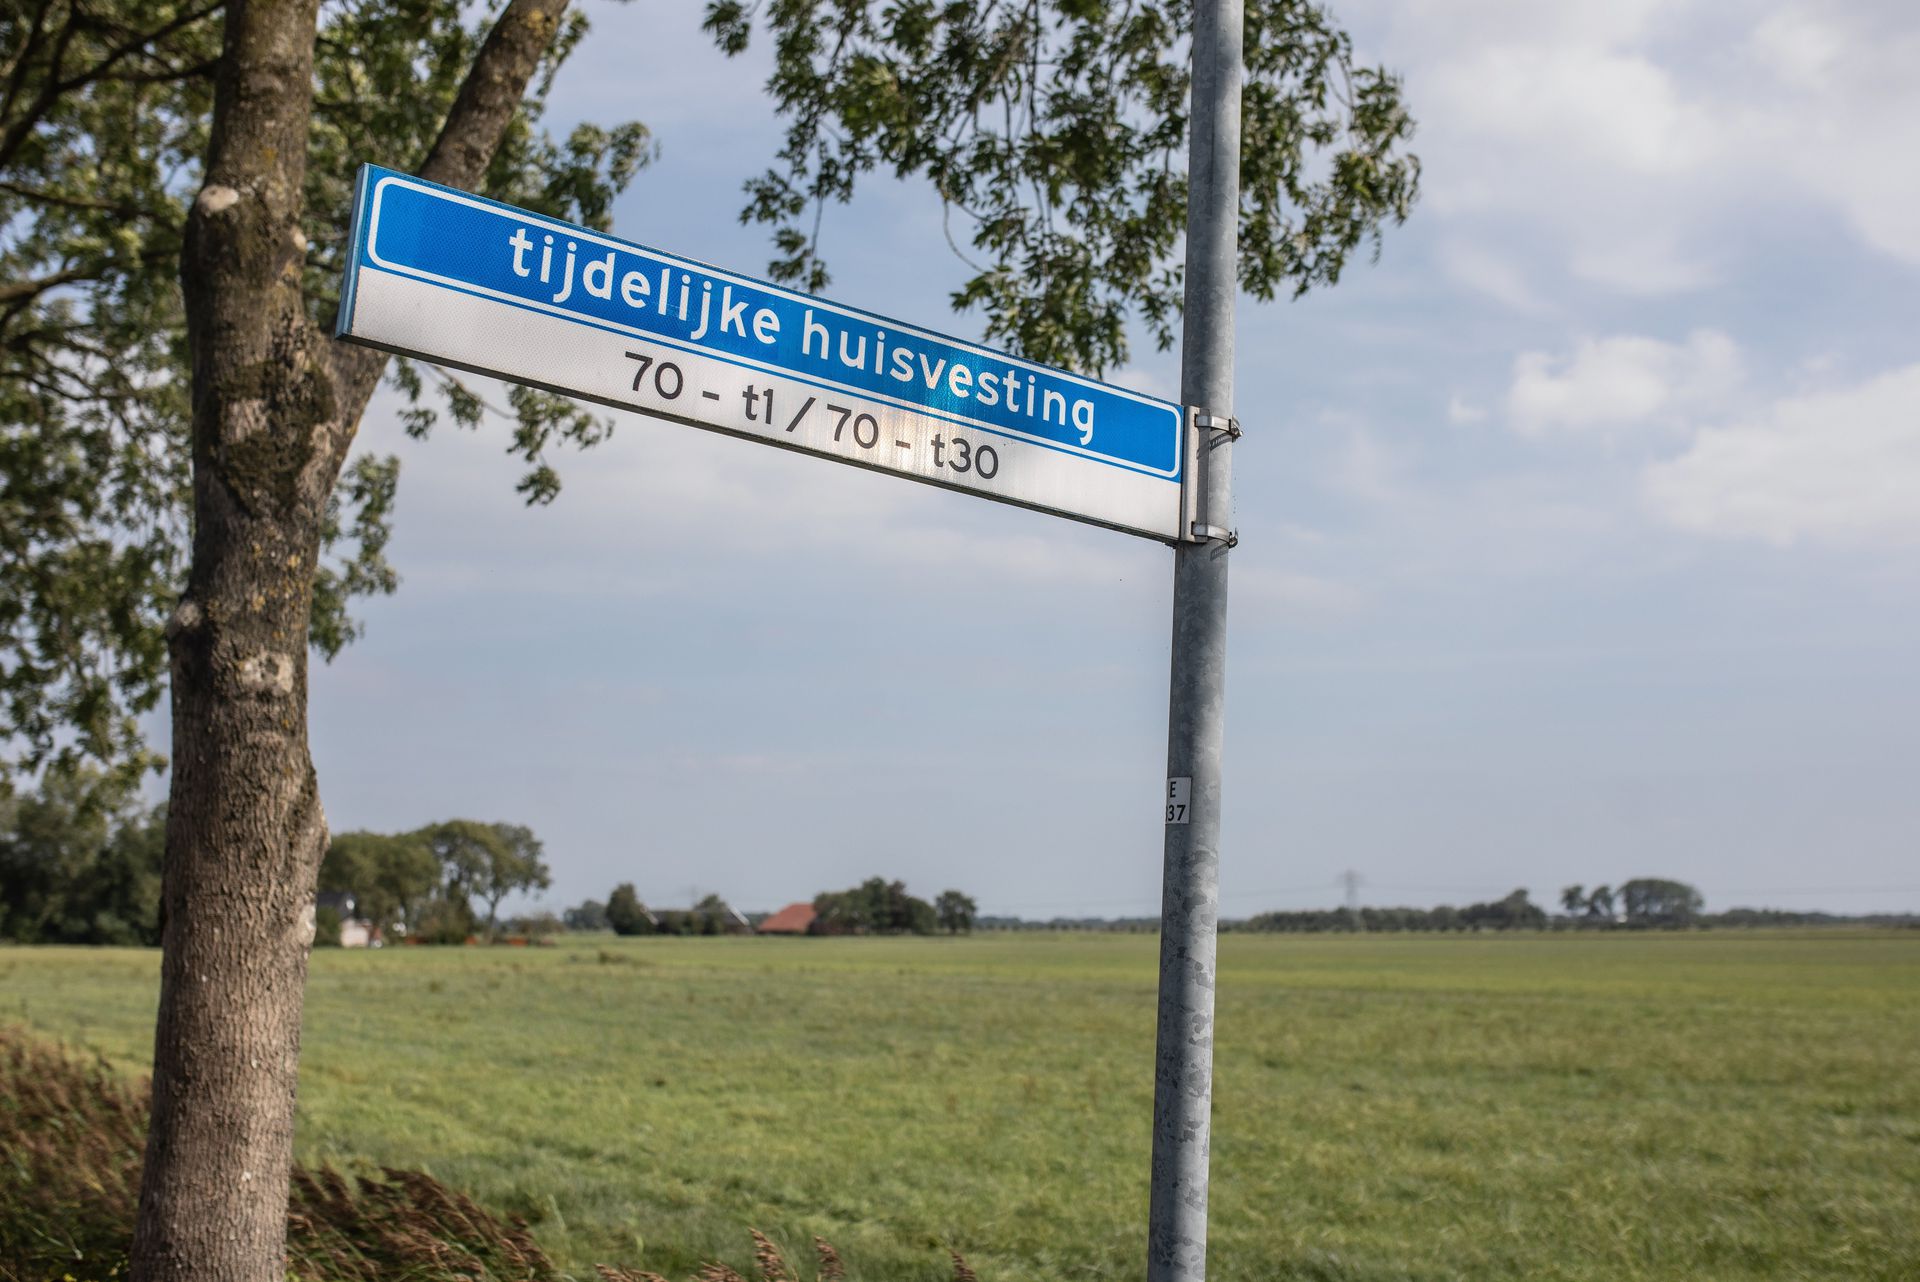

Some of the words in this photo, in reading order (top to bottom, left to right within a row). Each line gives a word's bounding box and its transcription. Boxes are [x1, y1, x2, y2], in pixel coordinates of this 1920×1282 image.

[508, 227, 781, 346] tijdelijke
[801, 308, 1096, 446] huisvesting
[624, 350, 684, 400] 70
[742, 384, 774, 425] t1
[826, 403, 879, 450] 70
[931, 433, 999, 480] t30
[1165, 804, 1186, 822] 37
[1169, 781, 1177, 798] E
